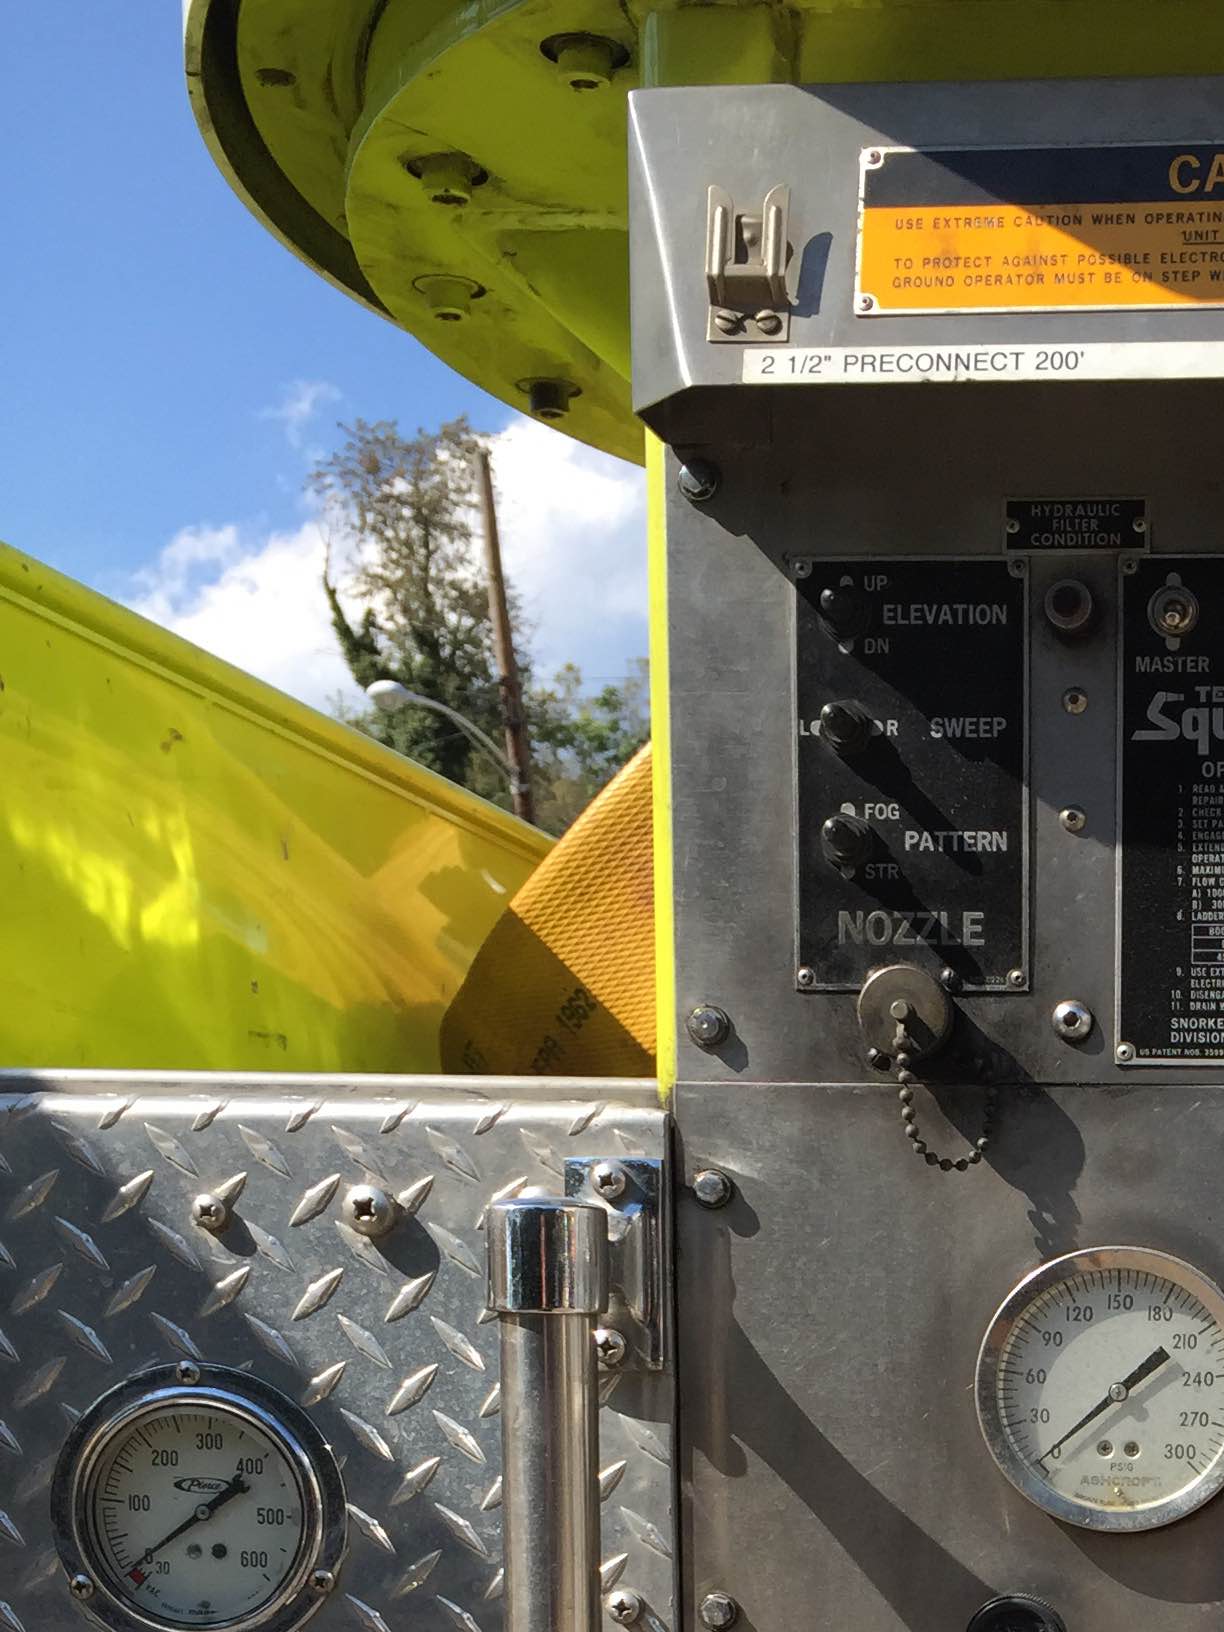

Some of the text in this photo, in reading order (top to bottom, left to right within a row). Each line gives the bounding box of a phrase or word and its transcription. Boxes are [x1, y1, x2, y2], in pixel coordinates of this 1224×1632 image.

[895, 216, 924, 231] USE
[932, 215, 1005, 230] EXTREME
[1012, 213, 1083, 229] CAUTION
[1091, 212, 1136, 227] WHEN
[1181, 227, 1220, 243] UNIT
[760, 351, 1085, 377] 2 1/2" PRECONNECT 200'
[1031, 503, 1121, 517] HYDRAULIC
[1052, 518, 1099, 532] FILTER
[1030, 532, 1121, 546] CONDITION
[863, 575, 888, 592] UP
[883, 602, 1007, 625] ELEVATION
[863, 638, 890, 655] DN
[1135, 655, 1210, 675] MASTER
[799, 719, 811, 737] L
[886, 719, 899, 737] R
[930, 717, 1007, 737] SWEEP
[863, 803, 900, 820] FOG
[904, 831, 1008, 851] PATTERN
[863, 863, 900, 880] STR
[837, 910, 986, 947] NOZZLE
[1107, 1293, 1134, 1311] 150
[1065, 1305, 1093, 1322] 120
[1147, 1305, 1173, 1322] 180
[1041, 1331, 1063, 1347] 90
[1172, 1333, 1198, 1350] 210
[1025, 1368, 1047, 1385] 60
[1182, 1370, 1214, 1387] 240
[1029, 1408, 1050, 1424] 30
[1179, 1411, 1210, 1428] 270
[195, 1432, 223, 1450] 300
[151, 1449, 179, 1467] 200
[1051, 1443, 1063, 1460] 0
[1163, 1443, 1197, 1460] 300
[235, 1457, 264, 1475] 400
[128, 1494, 151, 1512] 100
[256, 1507, 284, 1526] 500
[240, 1550, 268, 1568] 600
[155, 1560, 171, 1576] 30
